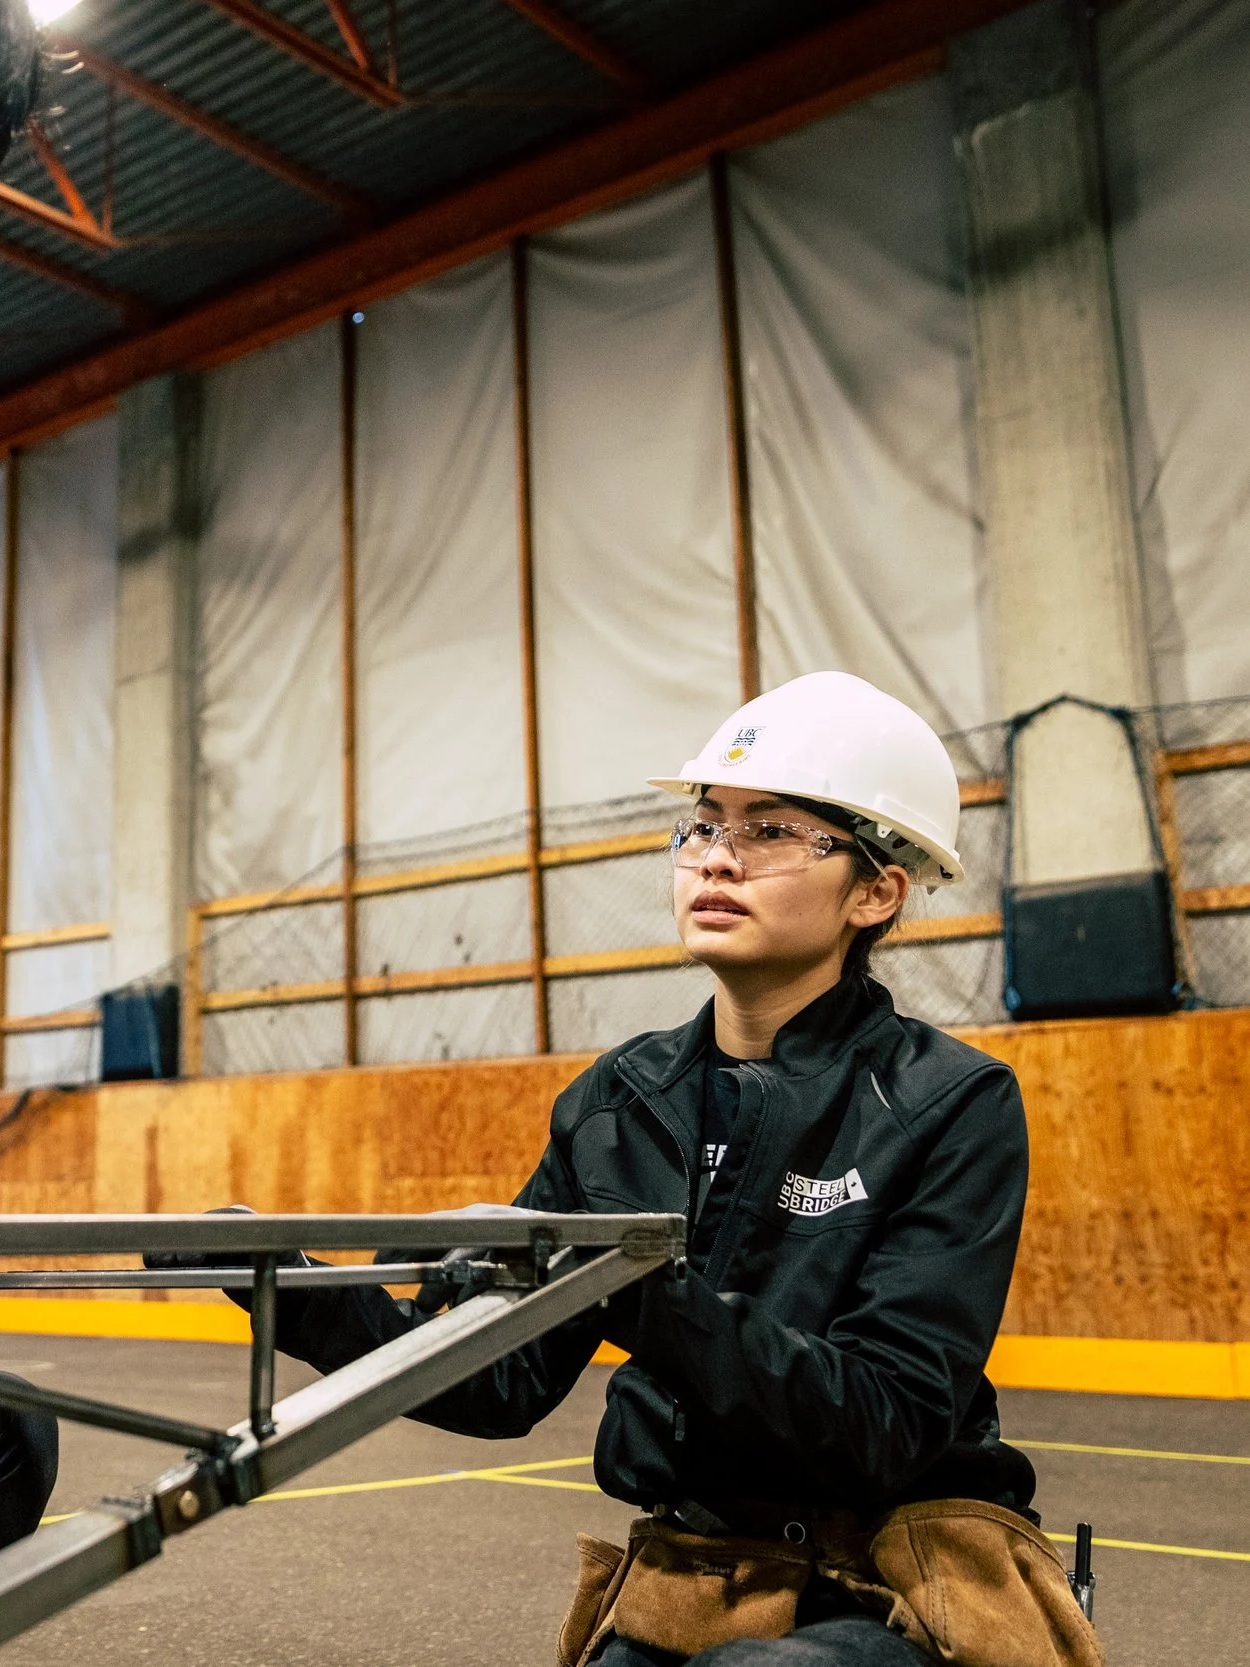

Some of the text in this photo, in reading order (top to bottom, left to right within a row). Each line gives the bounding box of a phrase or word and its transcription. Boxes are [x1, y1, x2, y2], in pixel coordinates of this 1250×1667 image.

[777, 1171, 794, 1209] UBC
[794, 1178, 845, 1196] STEEL
[790, 1189, 847, 1212] BRIDGE
